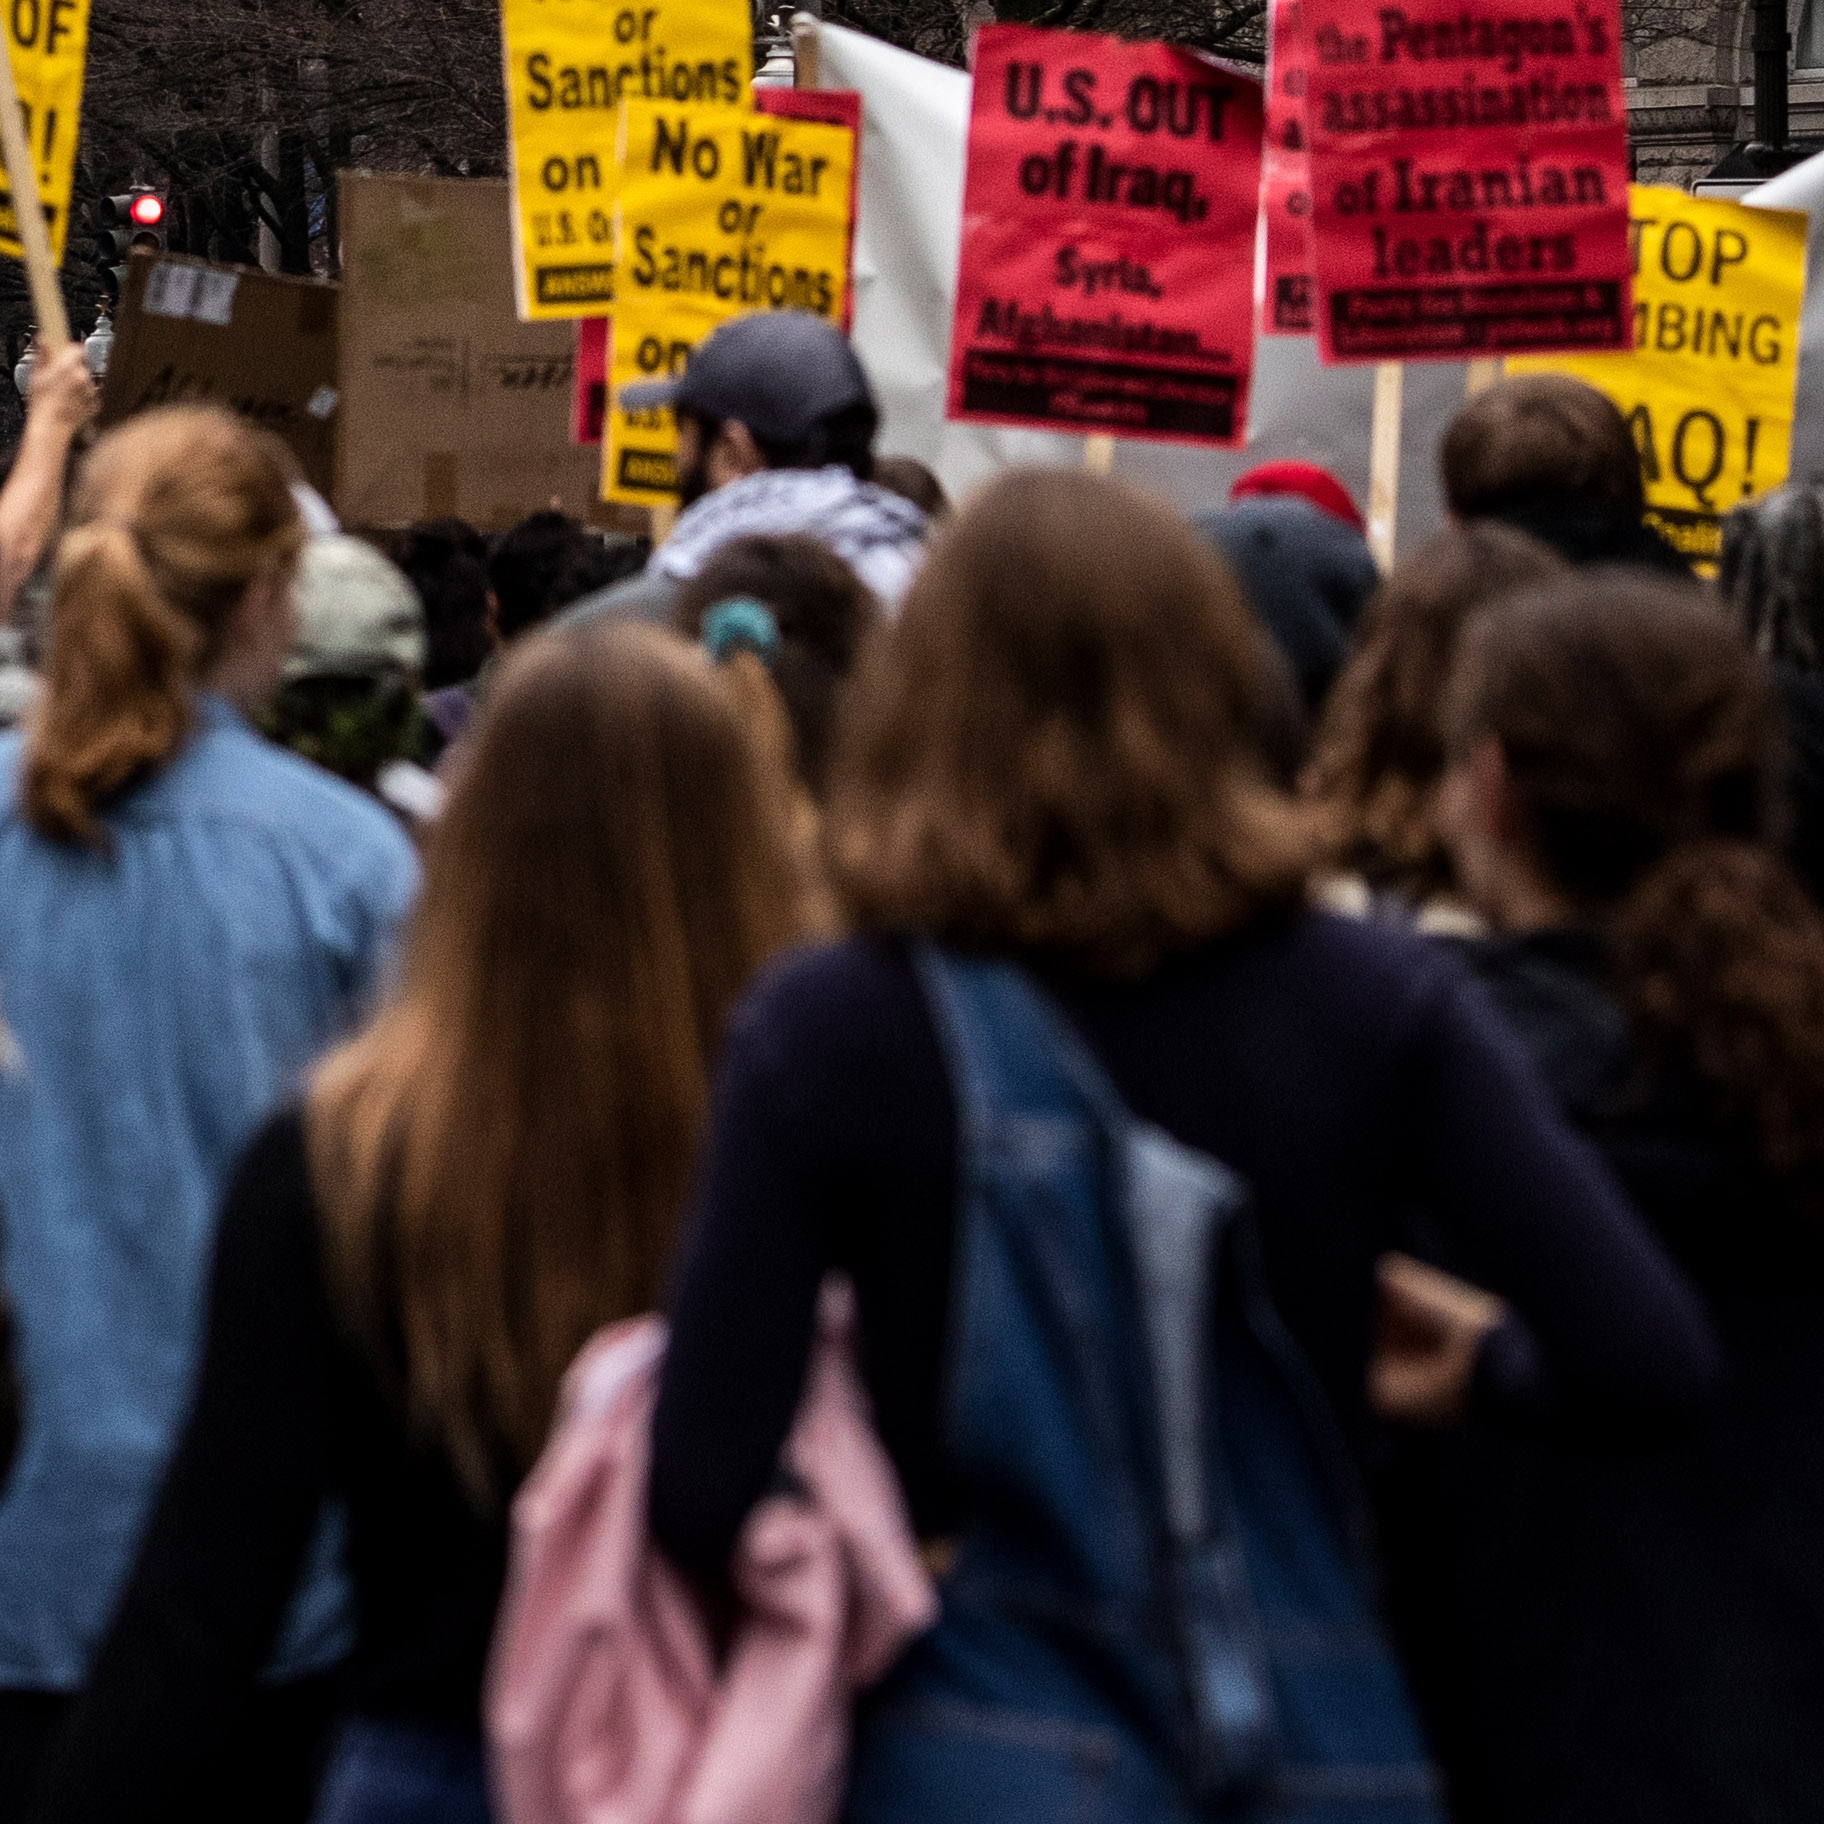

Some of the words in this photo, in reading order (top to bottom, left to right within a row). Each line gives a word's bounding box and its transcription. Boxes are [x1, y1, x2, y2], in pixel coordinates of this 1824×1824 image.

[613, 6, 658, 44] or
[1377, 0, 1607, 73] Pentagon's
[525, 46, 742, 114] Sanctions
[1004, 60, 1113, 129] U.S.
[1125, 74, 1234, 142] OUT
[541, 151, 602, 192] on
[651, 116, 722, 181] No
[741, 128, 829, 198] War
[1020, 138, 1077, 198] of
[1085, 142, 1210, 224] Iraq,
[1392, 152, 1605, 213] Iranian
[717, 199, 765, 235] or
[1372, 220, 1576, 276] leaders
[631, 225, 834, 316] Sanctions
[1630, 219, 1749, 286] TOP
